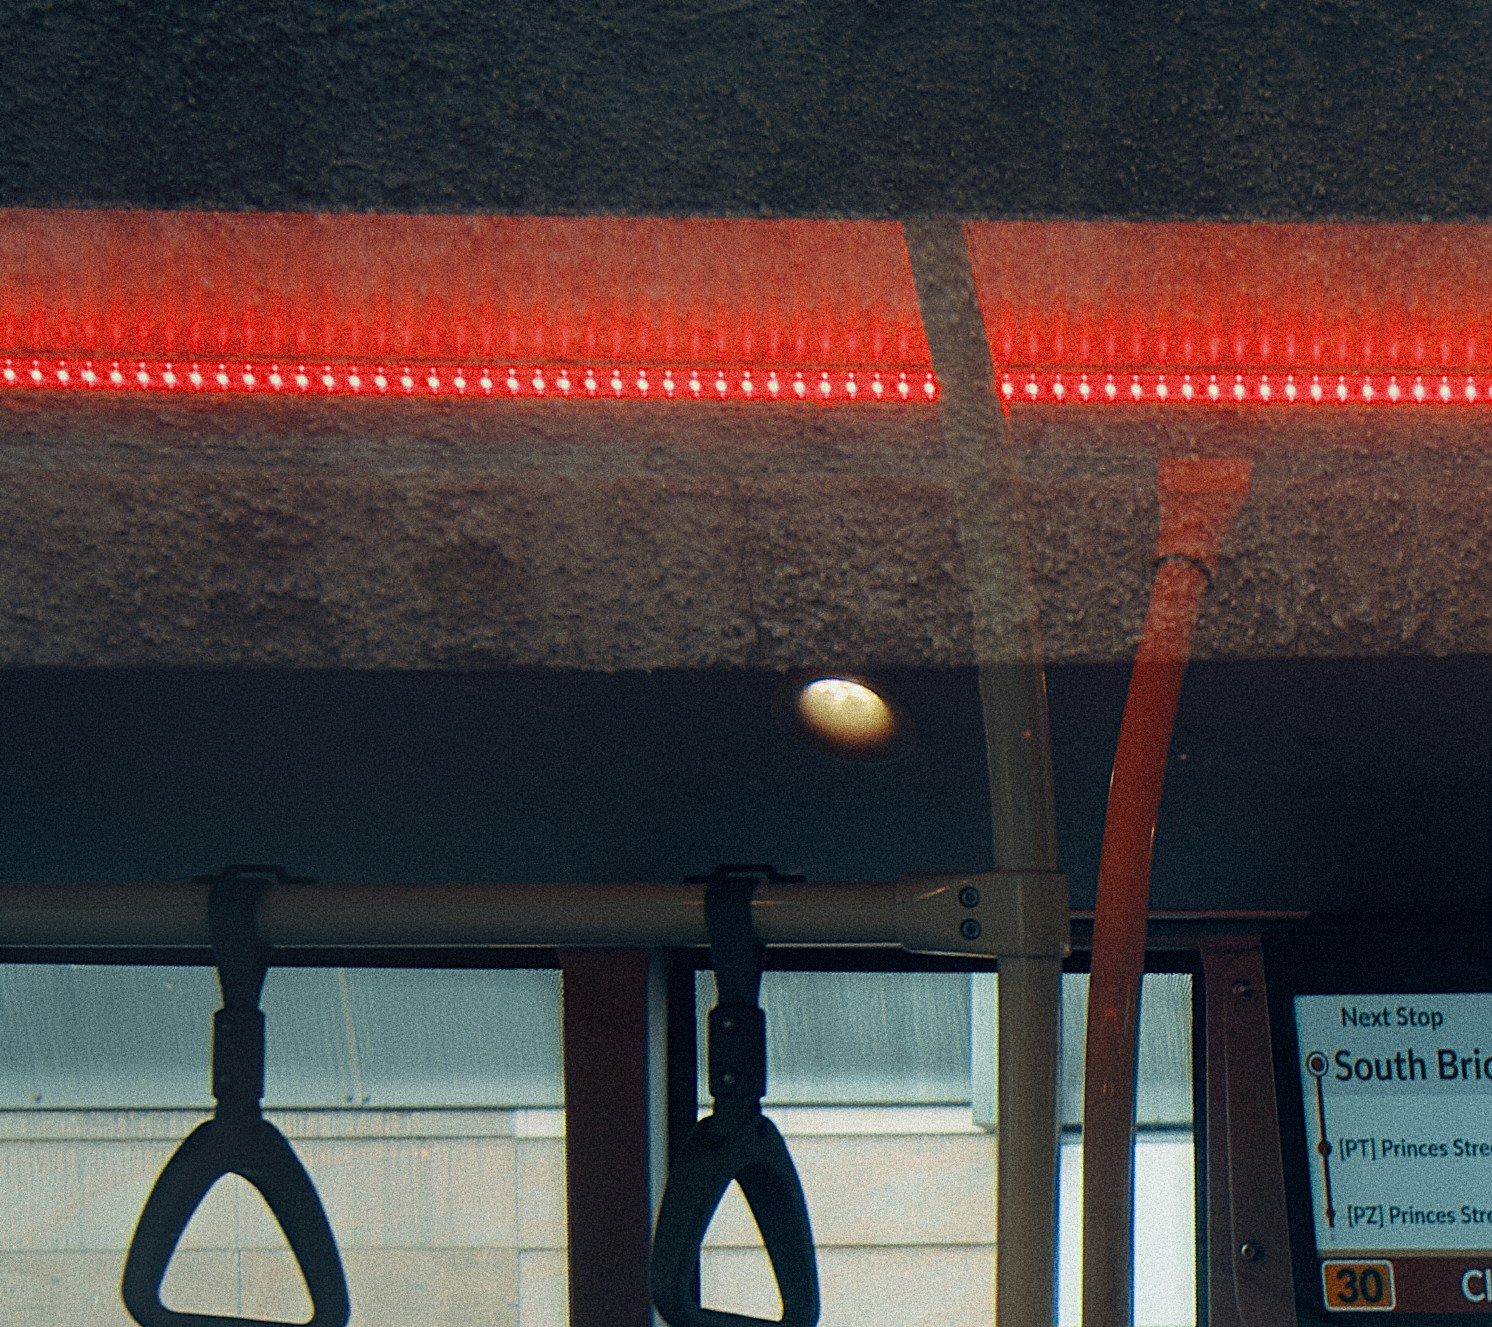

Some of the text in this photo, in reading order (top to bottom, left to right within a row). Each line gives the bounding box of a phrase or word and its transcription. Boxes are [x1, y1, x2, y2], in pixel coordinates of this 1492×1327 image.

[1341, 1005, 1444, 1032] Next Stop
[1334, 1047, 1428, 1081] South
[1339, 1136, 1377, 1161] [PT]
[1382, 1138, 1448, 1158] Princes
[1347, 1203, 1384, 1229] [PZ]
[1390, 1205, 1456, 1226] Princes
[1337, 1269, 1385, 1303] 30
